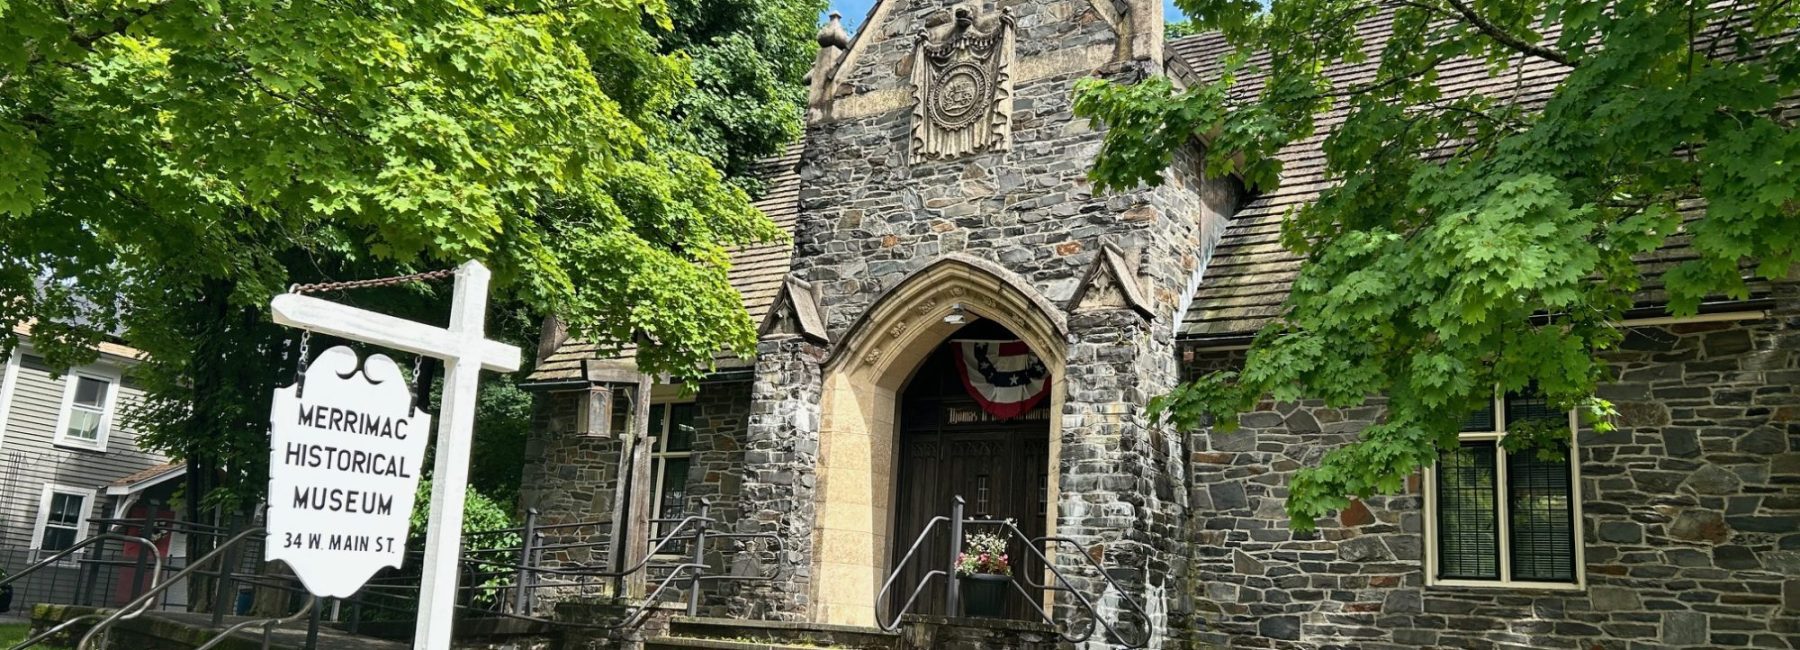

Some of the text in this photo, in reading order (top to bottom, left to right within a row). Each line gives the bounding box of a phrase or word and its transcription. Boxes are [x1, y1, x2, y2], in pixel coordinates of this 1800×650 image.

[298, 403, 408, 440] MERRIMAC
[285, 442, 411, 478] HISTORICAL
[293, 485, 393, 516] MUSEUM
[283, 532, 395, 554] 34 W. MAIN ST.
